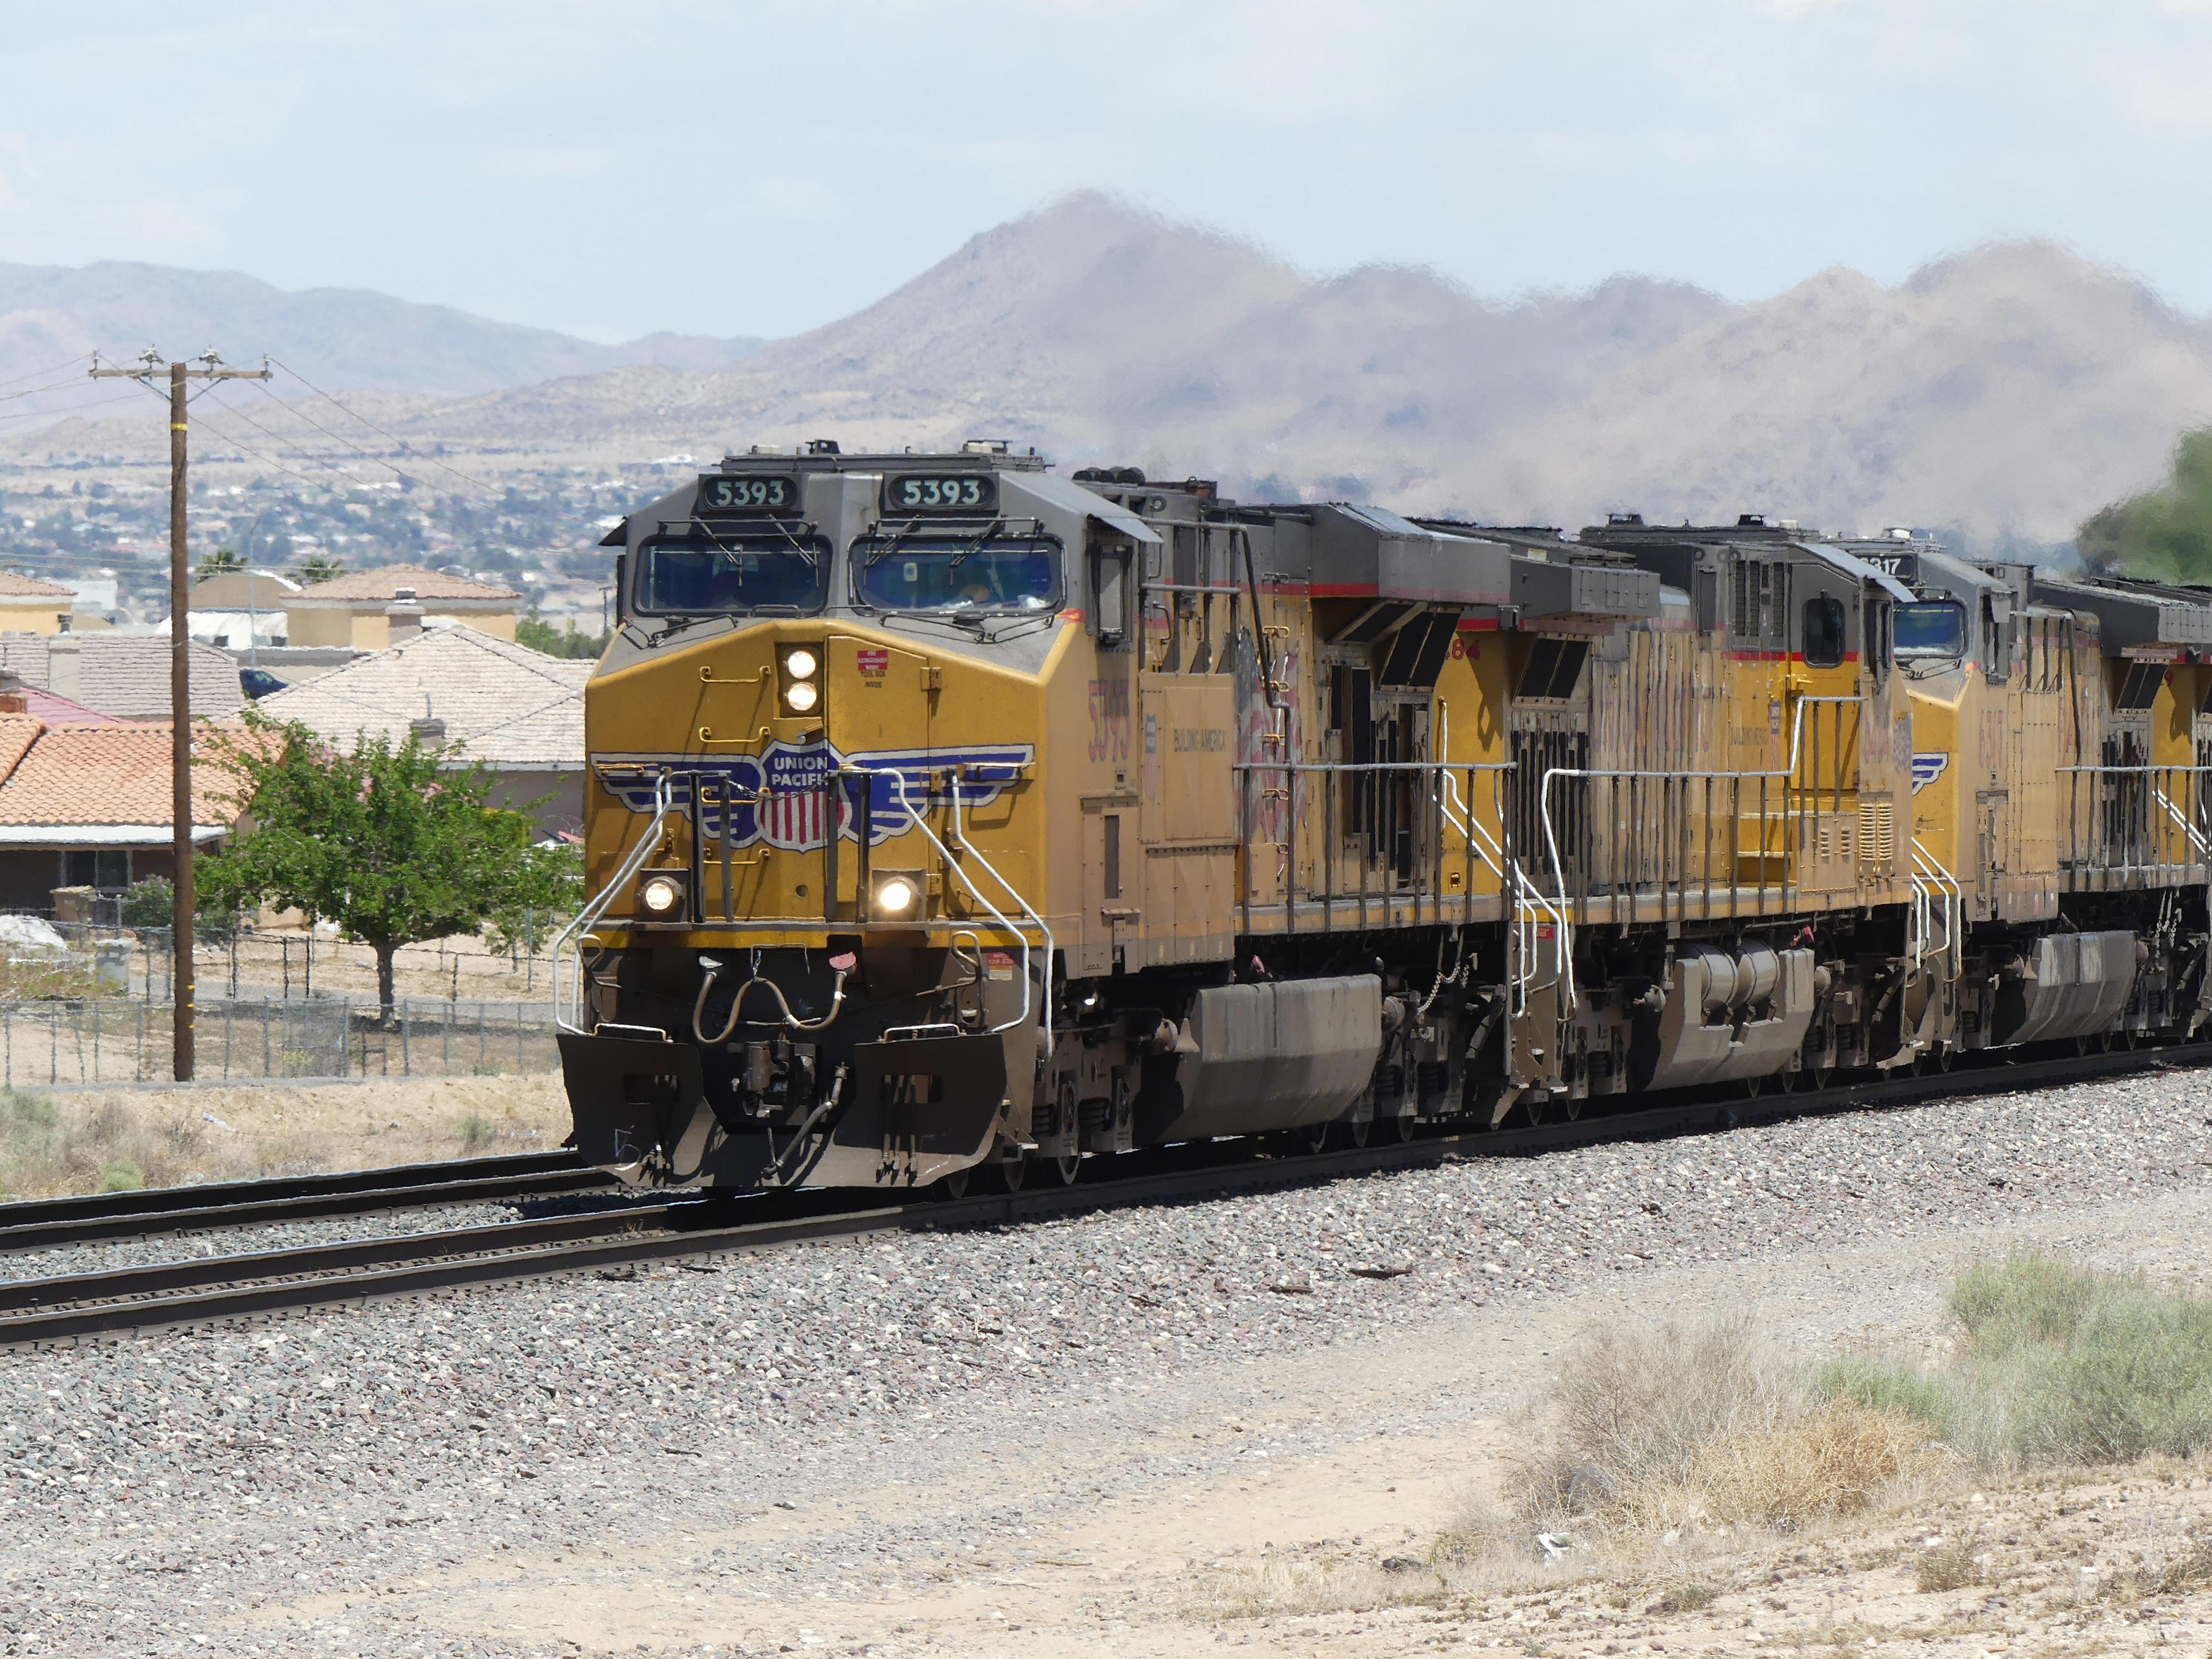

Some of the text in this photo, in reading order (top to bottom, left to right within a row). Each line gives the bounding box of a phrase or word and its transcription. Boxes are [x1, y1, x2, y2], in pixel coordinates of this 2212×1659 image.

[716, 480, 784, 506] 5393
[903, 480, 980, 505] 5393
[1859, 557, 1901, 575] 317
[774, 757, 827, 770] UNION
